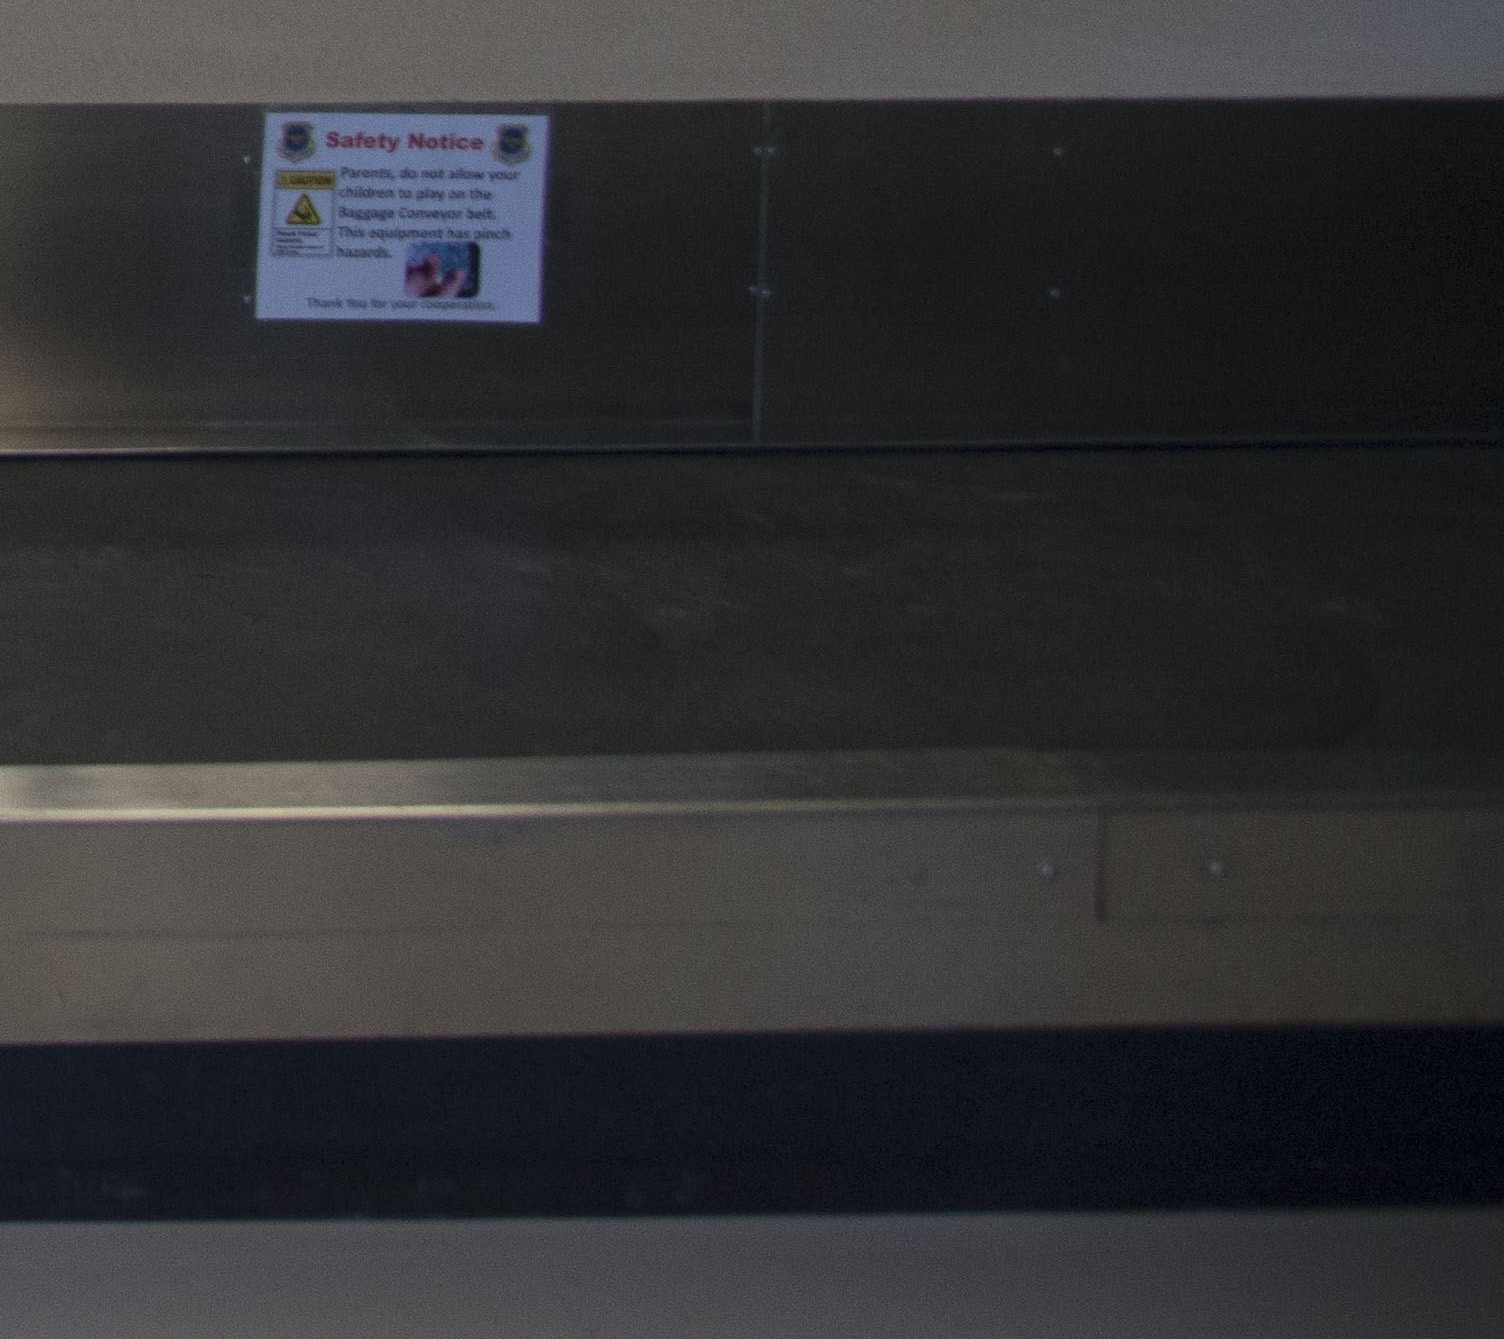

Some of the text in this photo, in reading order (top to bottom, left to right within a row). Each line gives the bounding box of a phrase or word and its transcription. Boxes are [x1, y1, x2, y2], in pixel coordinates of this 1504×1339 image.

[325, 131, 485, 153] Safety Notice
[340, 167, 519, 182] Parents, do not allow your
[338, 187, 493, 201] children to play on the
[338, 206, 395, 221] Baggage
[398, 207, 462, 221] Conveyor
[337, 226, 512, 241] This equipment has pinch
[307, 297, 343, 309] Thank
